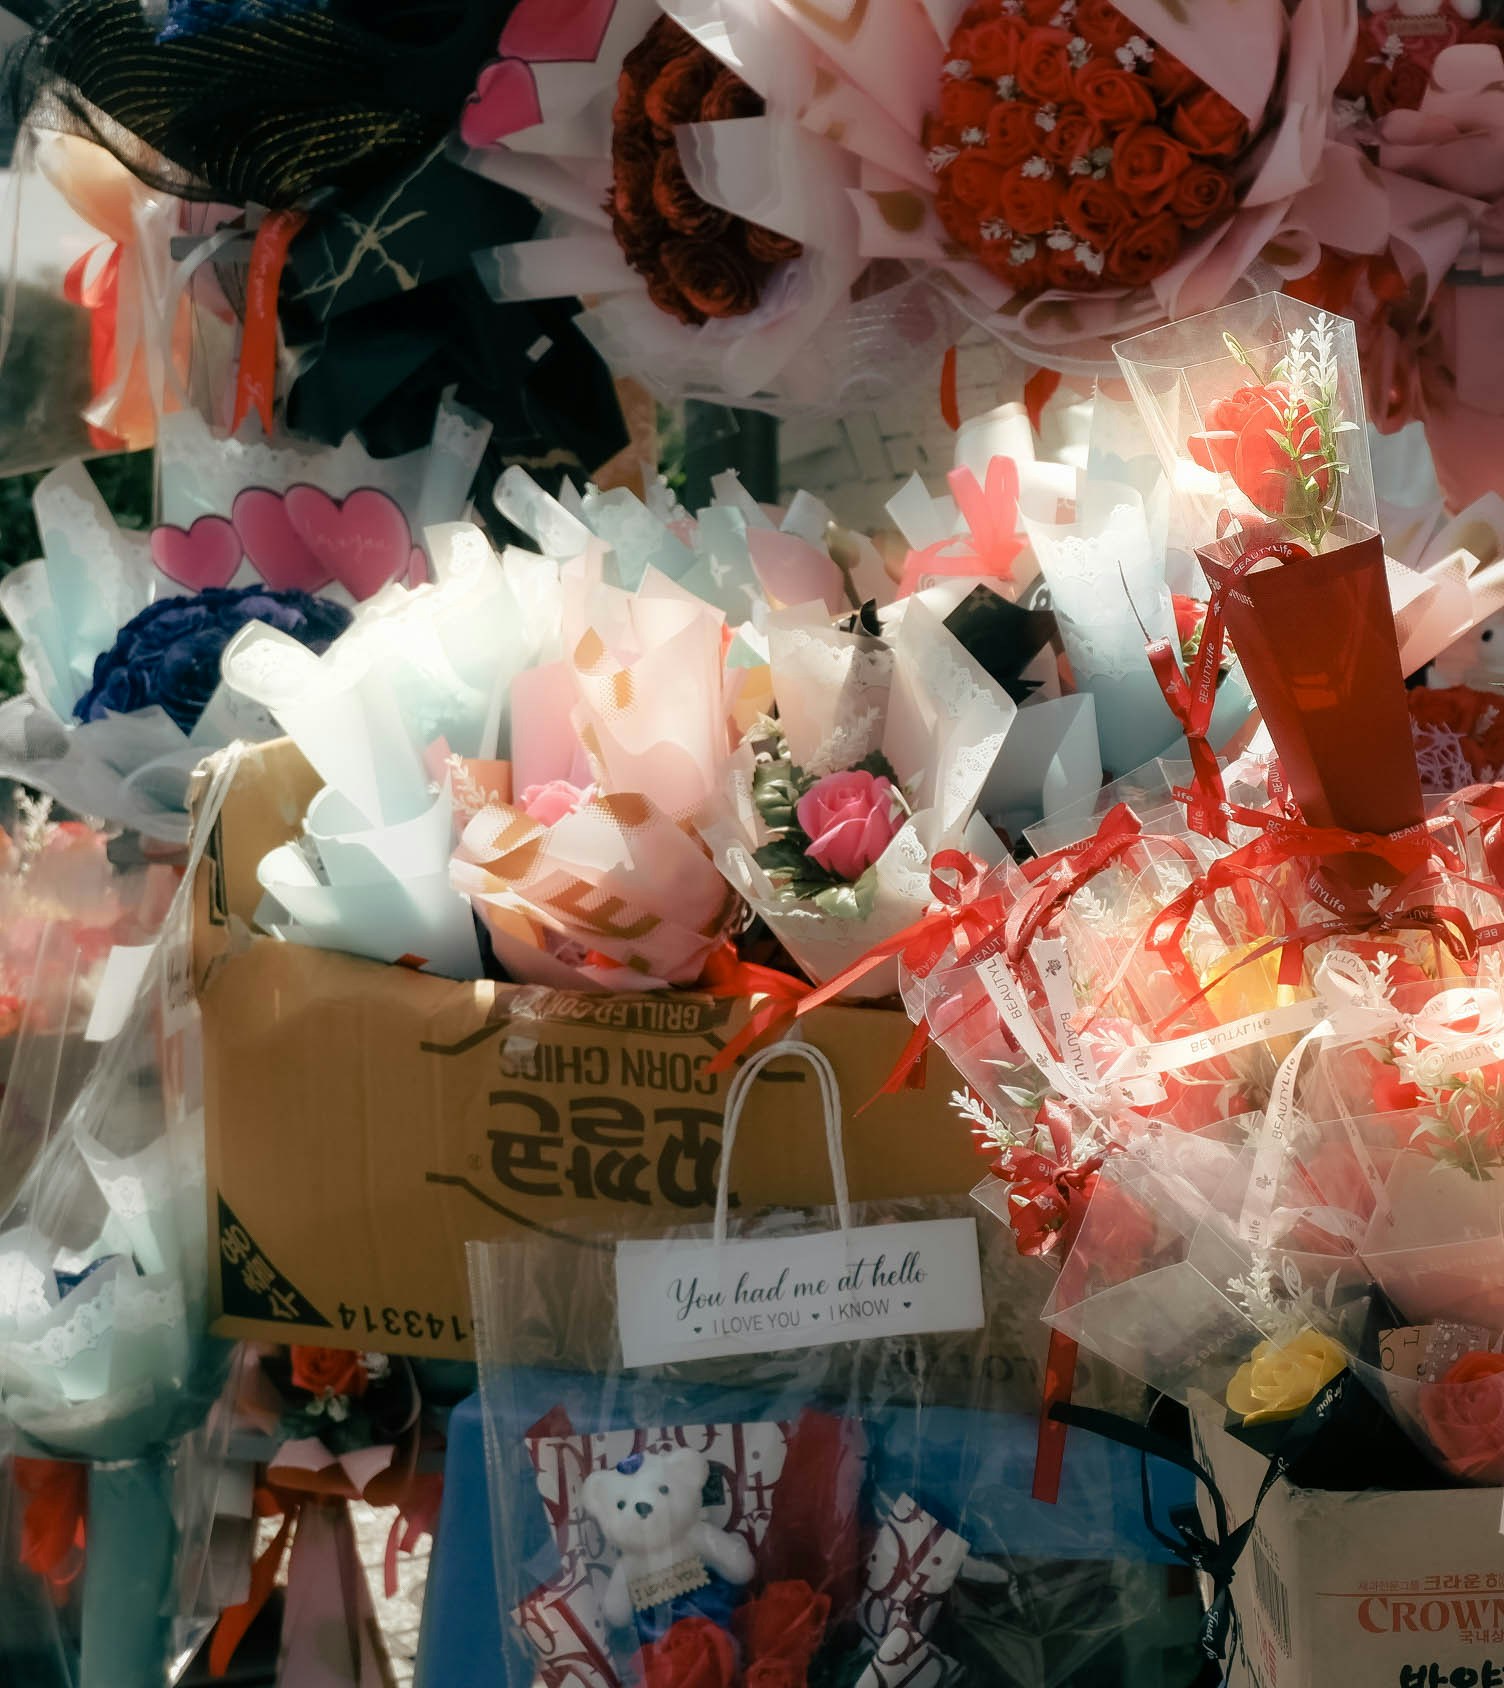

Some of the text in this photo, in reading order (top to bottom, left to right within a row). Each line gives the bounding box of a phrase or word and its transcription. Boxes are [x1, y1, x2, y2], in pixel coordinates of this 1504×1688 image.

[1232, 544, 1293, 576] BEAUTYLife
[1199, 642, 1216, 705] BEAUTYLife
[1271, 1056, 1297, 1140] BEAUTYLife
[487, 1090, 743, 1209] 꼬깔콘
[1249, 1219, 1262, 1241] Life
[220, 1223, 299, 1321] 수출용
[666, 1250, 929, 1321] You had me at hello
[338, 1303, 480, 1342] 143314
[721, 1313, 763, 1336] LOVE
[767, 1309, 802, 1330] YOU
[838, 1298, 891, 1320] KNOW
[1423, 1573, 1482, 1592] 크라운
